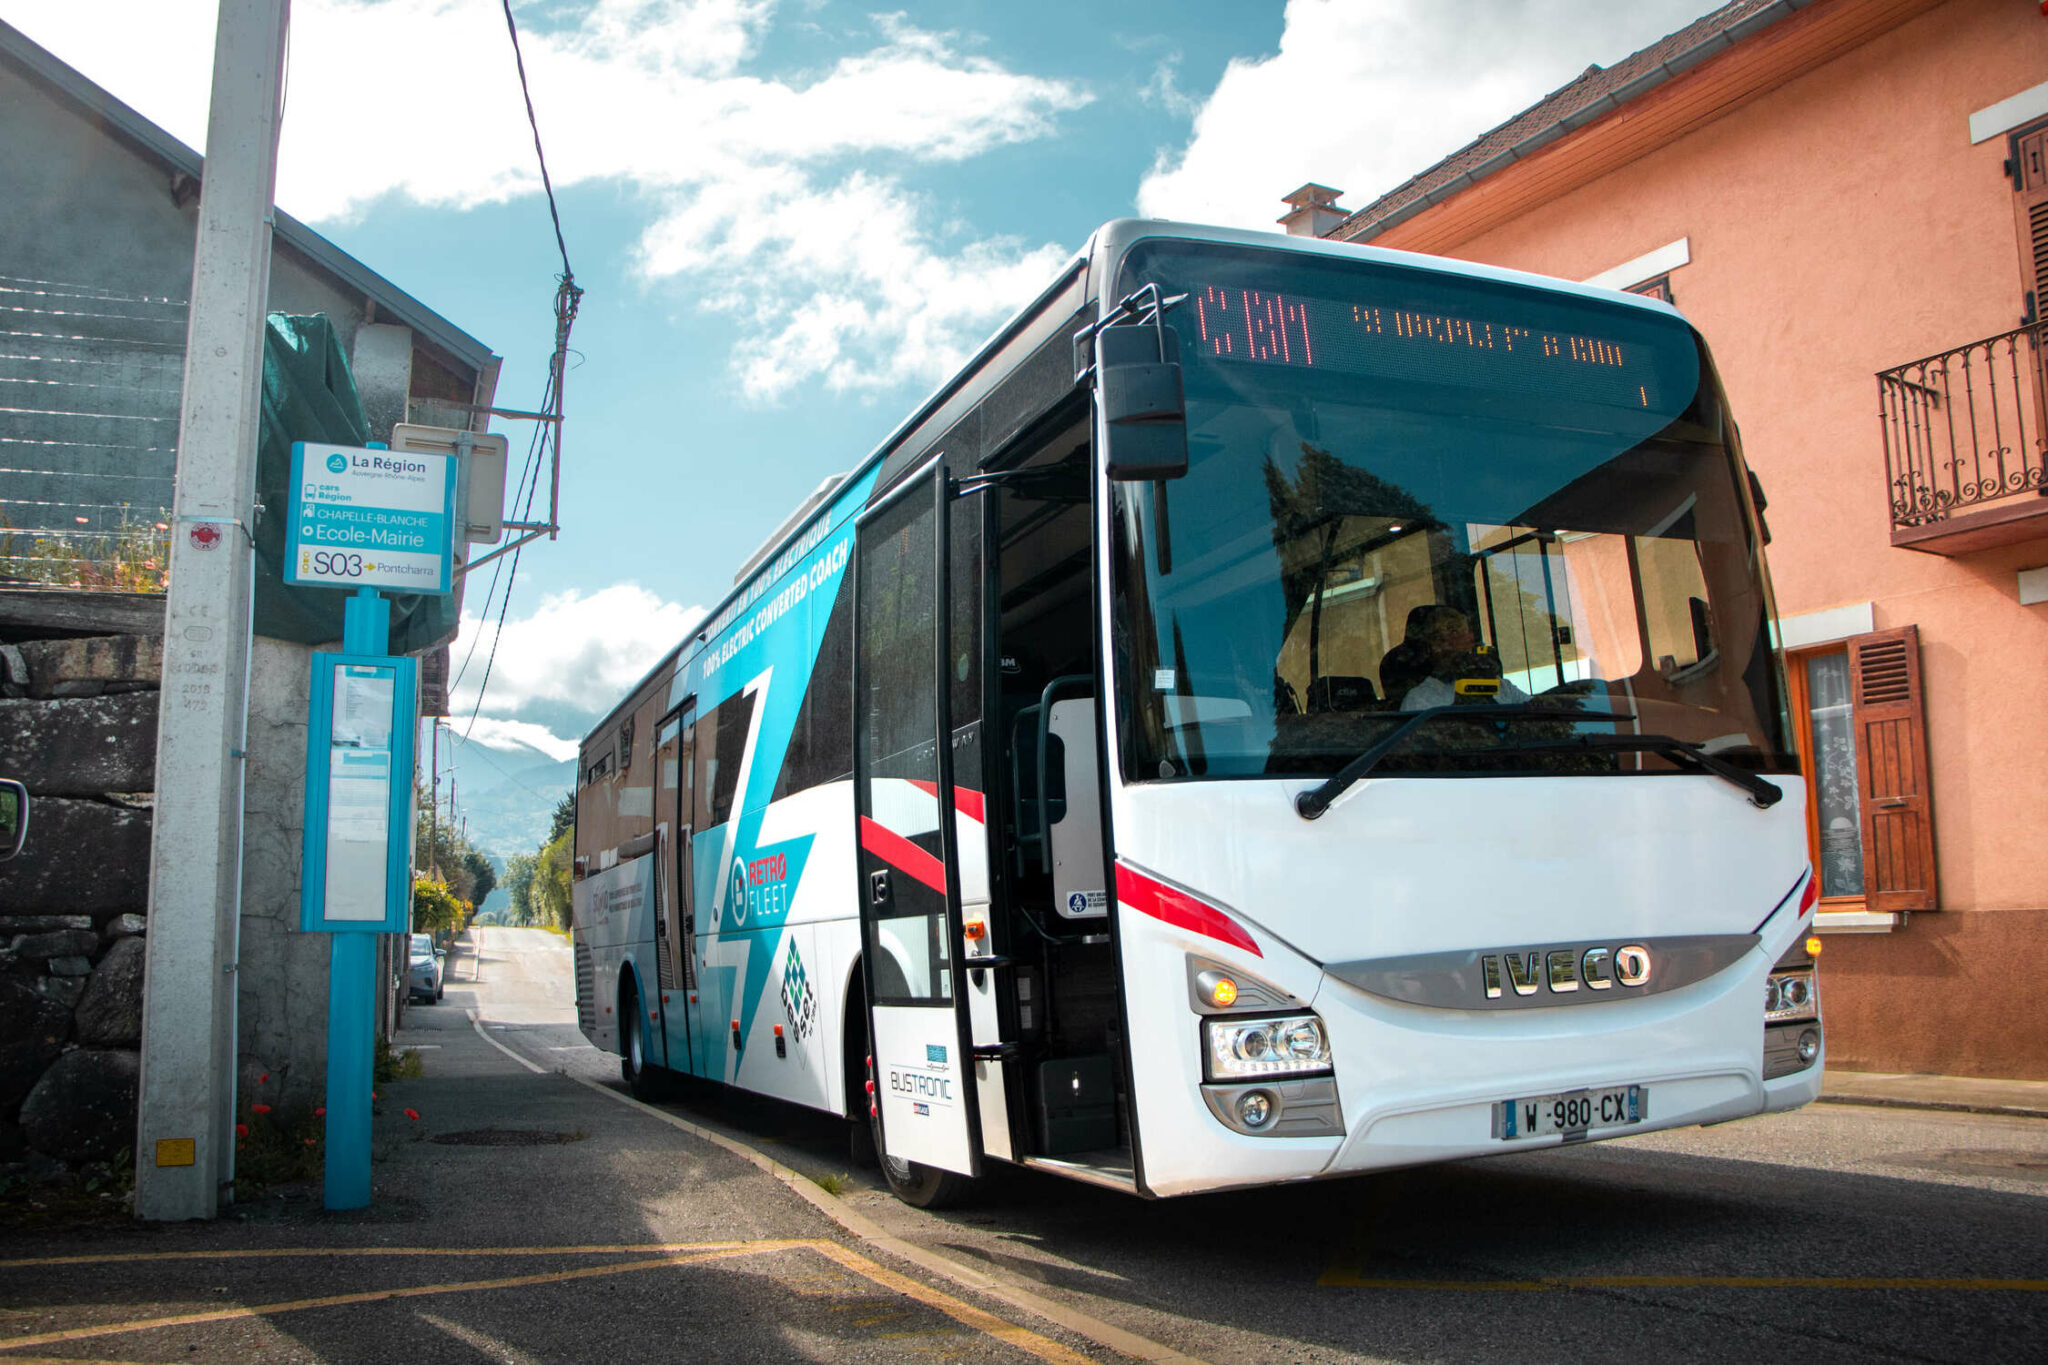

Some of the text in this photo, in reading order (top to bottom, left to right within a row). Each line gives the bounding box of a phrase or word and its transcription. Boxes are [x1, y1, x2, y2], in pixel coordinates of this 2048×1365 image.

[352, 455, 427, 473] La Région
[318, 492, 352, 502] Région
[319, 483, 341, 492] cars
[317, 508, 429, 528] CHAPELLE-BLANCHE
[316, 524, 425, 547] Ecole-Mairie
[313, 551, 434, 577] S03 Pontcharra
[703, 536, 849, 681] 100% ELECTRIC CONVERTED COACH
[748, 851, 787, 887] RETRO
[749, 883, 788, 917] FLEET
[1482, 944, 1652, 1000] IVECO
[890, 1070, 953, 1100] BUSTRONIC
